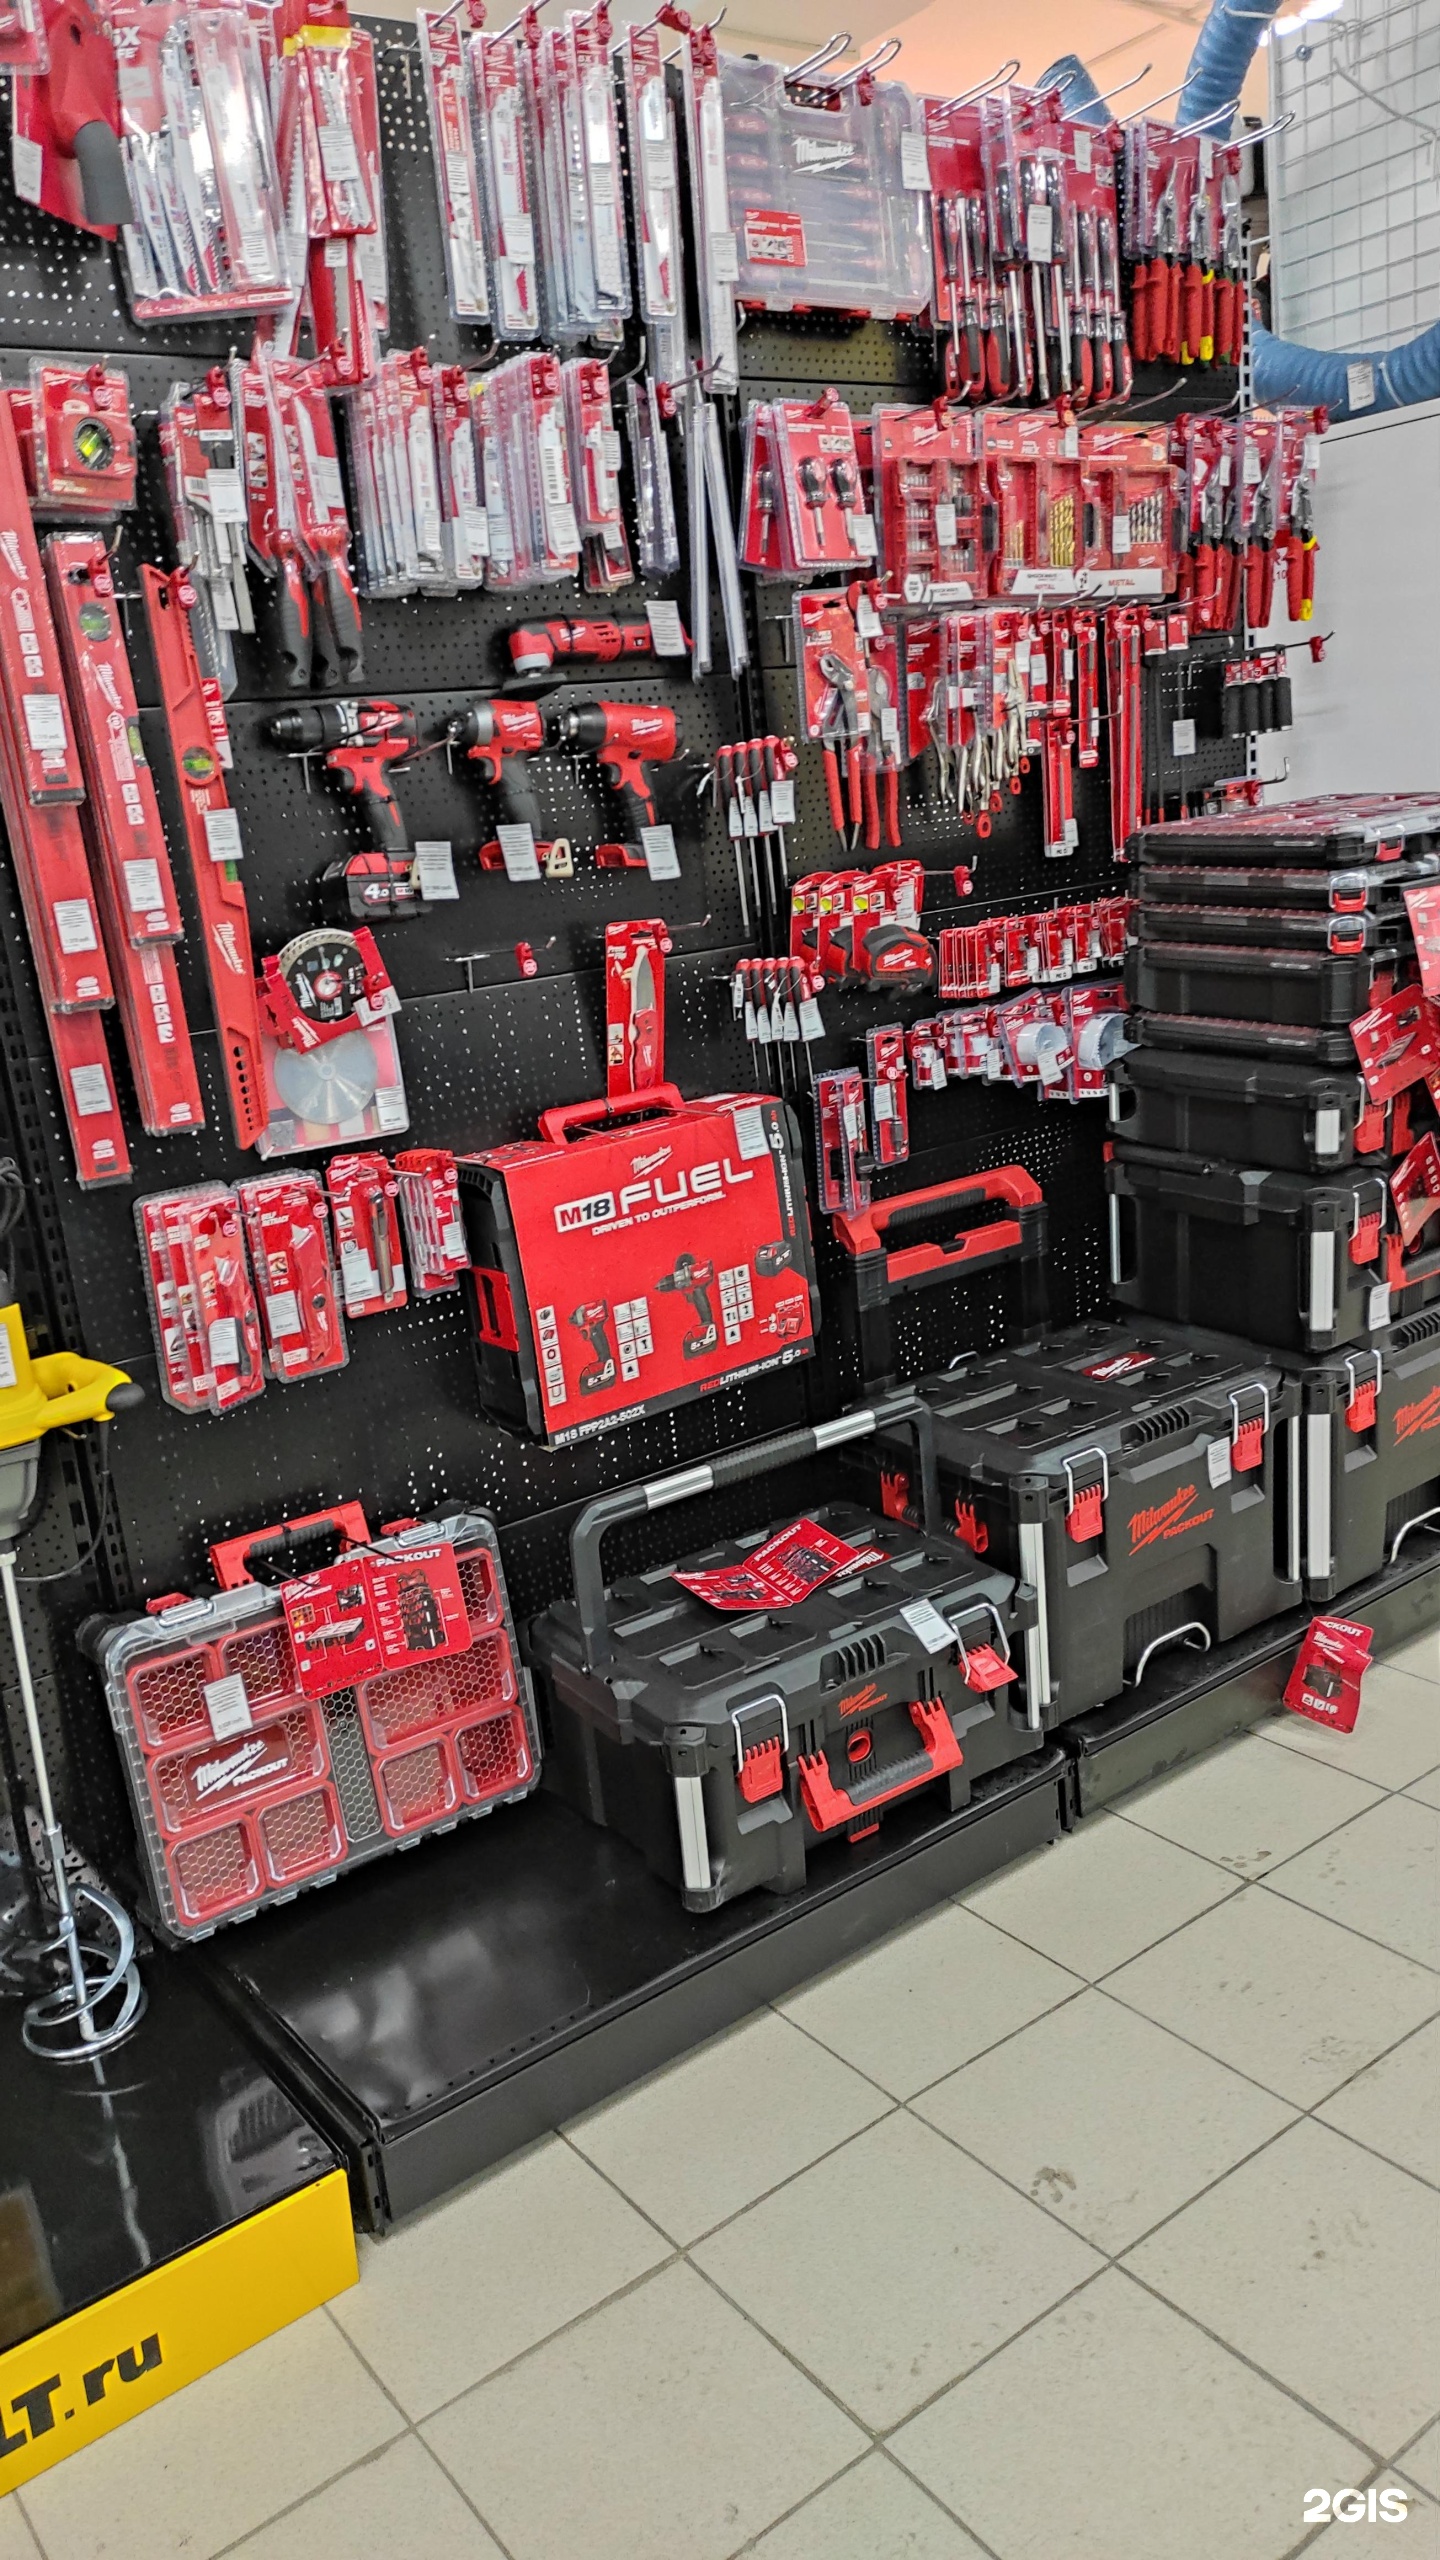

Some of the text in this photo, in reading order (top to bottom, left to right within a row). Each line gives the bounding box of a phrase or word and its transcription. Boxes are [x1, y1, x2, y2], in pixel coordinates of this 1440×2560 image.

[216, 921, 245, 975] Milwaukee
[561, 1157, 754, 1228] M18 FUEL
[591, 1216, 634, 1237] DRIVEN
[635, 1211, 651, 1224] TO
[1127, 1485, 1196, 1544] Milwaukee
[1163, 1509, 1215, 1540] PACKOUT
[753, 1523, 803, 1563] PACKOUT
[191, 1739, 266, 1791] Milwaukee
